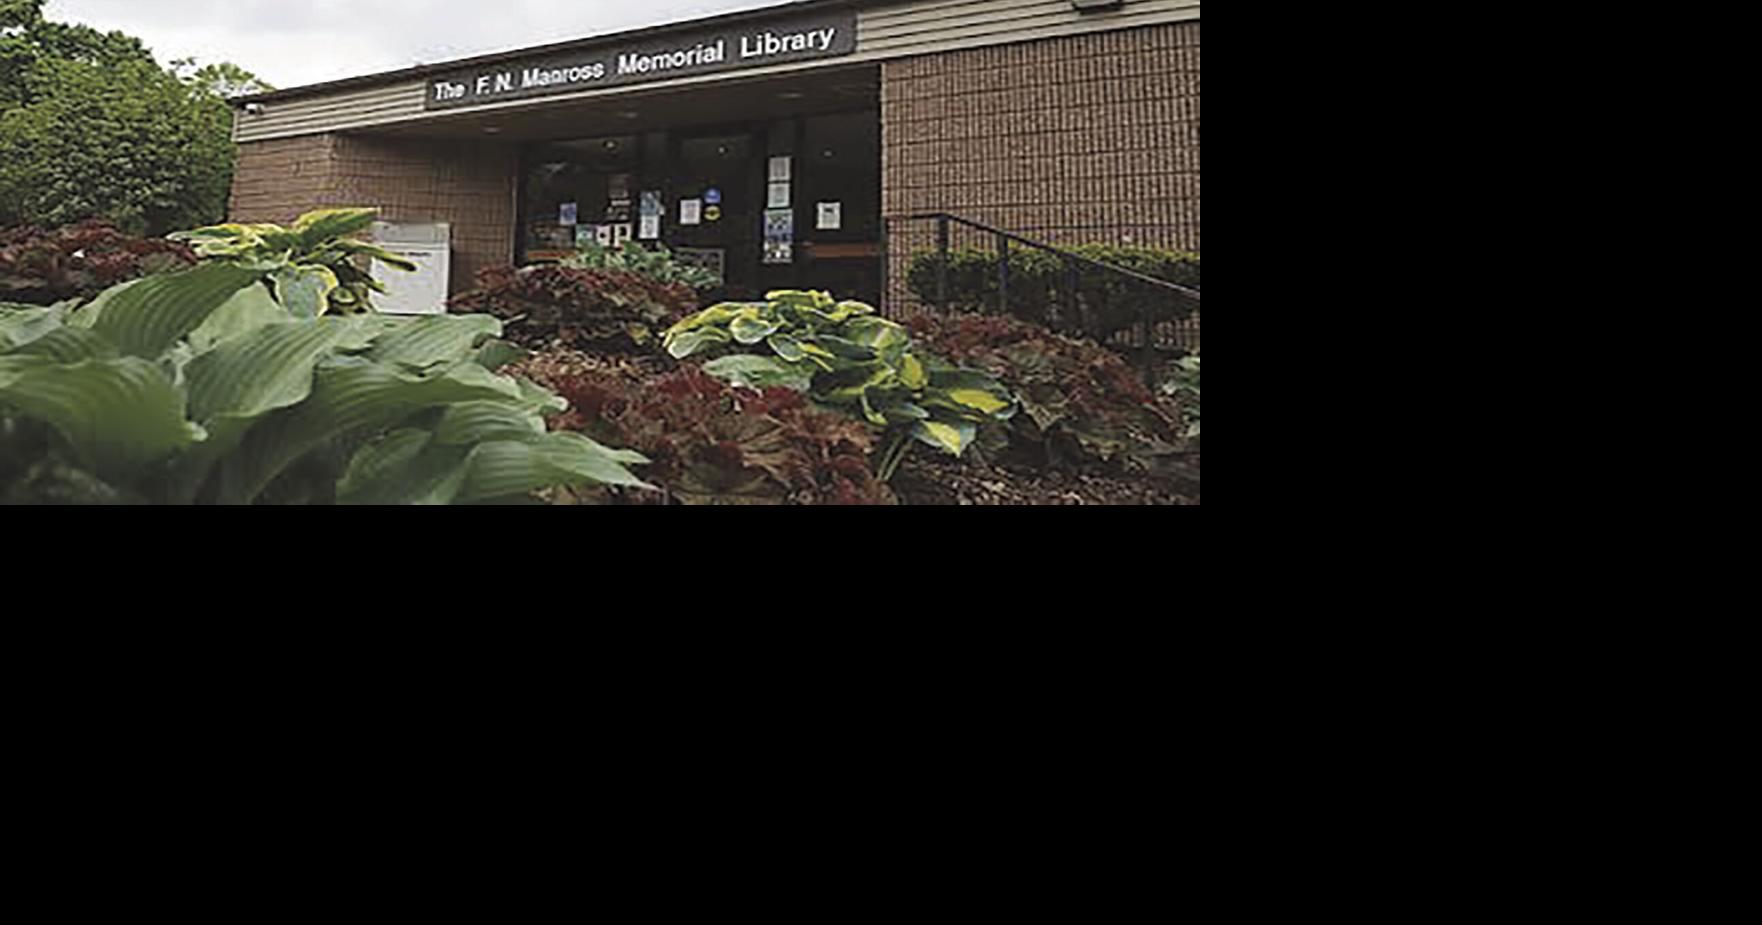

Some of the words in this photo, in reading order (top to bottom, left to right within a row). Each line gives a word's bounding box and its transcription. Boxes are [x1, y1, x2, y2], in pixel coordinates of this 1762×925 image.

[434, 81, 465, 100] The
[521, 61, 605, 88] Manross
[617, 40, 724, 75] Memorial
[741, 28, 836, 58] Library
